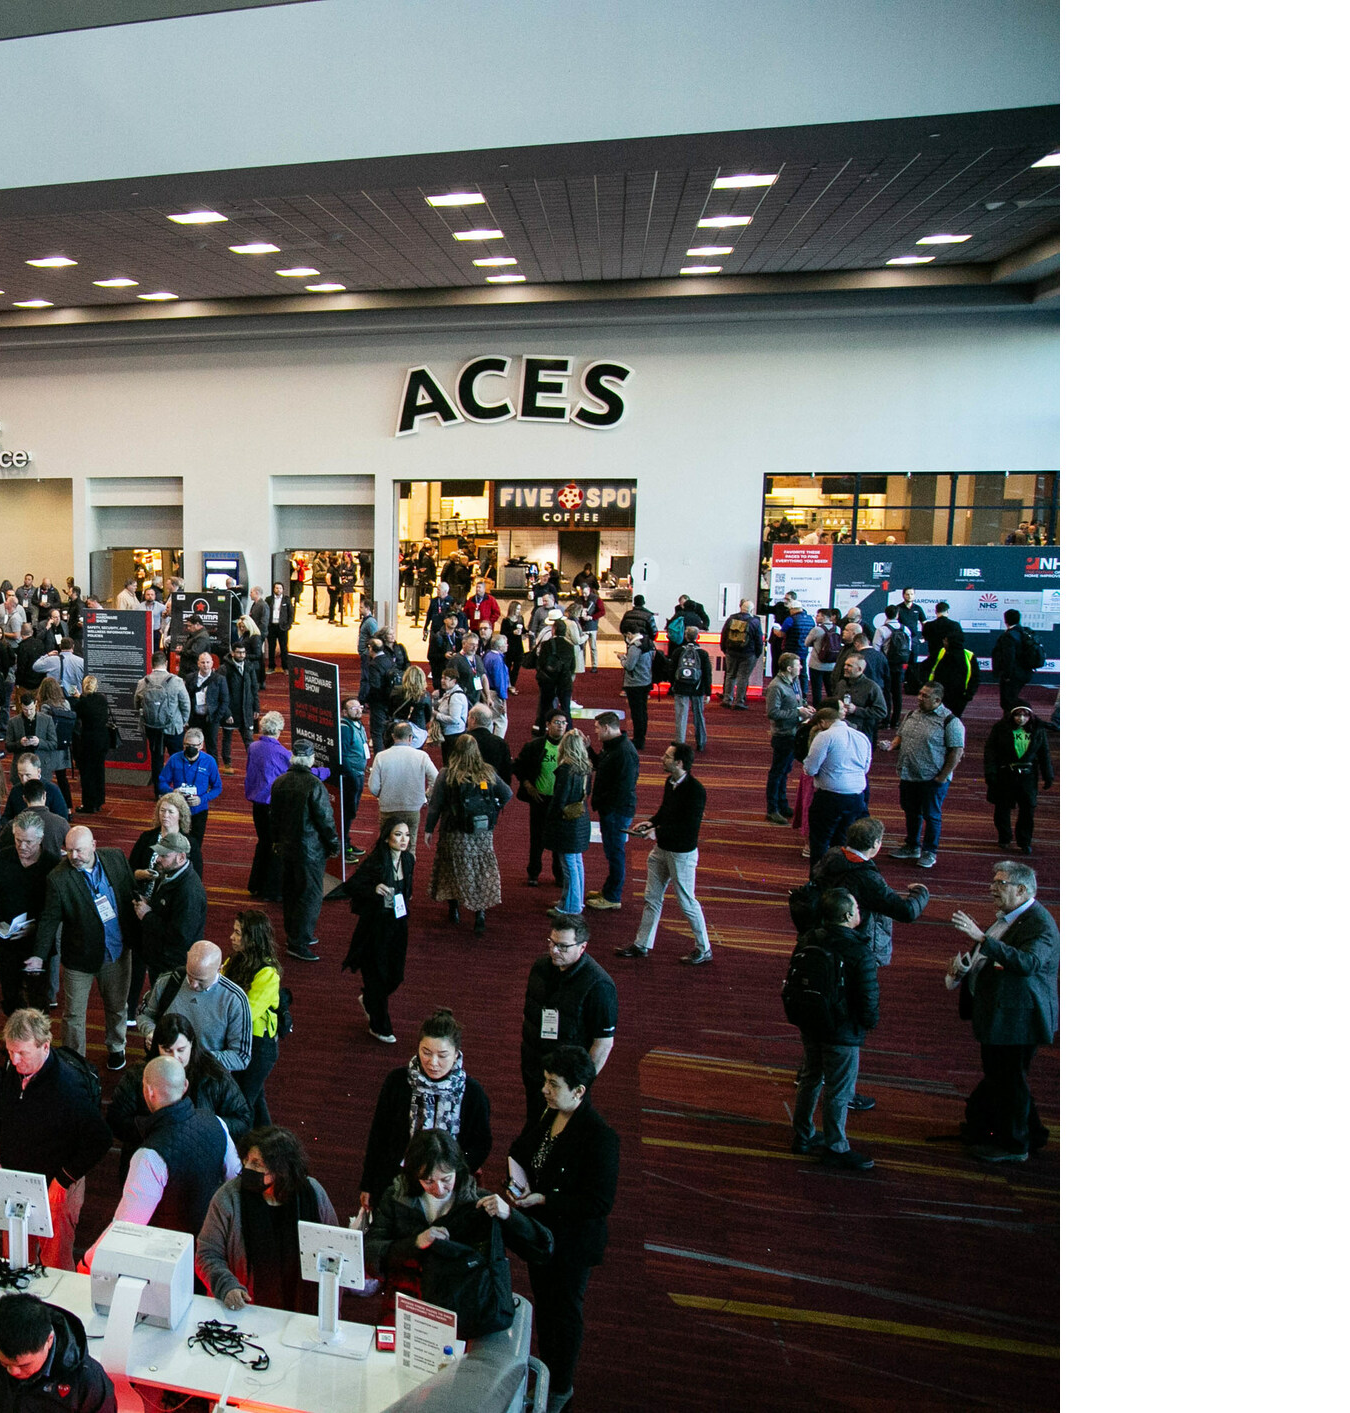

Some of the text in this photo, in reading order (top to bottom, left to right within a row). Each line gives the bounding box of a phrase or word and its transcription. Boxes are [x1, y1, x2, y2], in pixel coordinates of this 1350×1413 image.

[395, 355, 635, 437] ACES
[500, 488, 637, 508] FIVE SPO
[543, 512, 599, 523] COFFEE
[873, 562, 892, 573] DCW
[304, 675, 333, 689] HARDWARE
[305, 683, 320, 693] SHOW
[296, 727, 316, 740] MARCH
